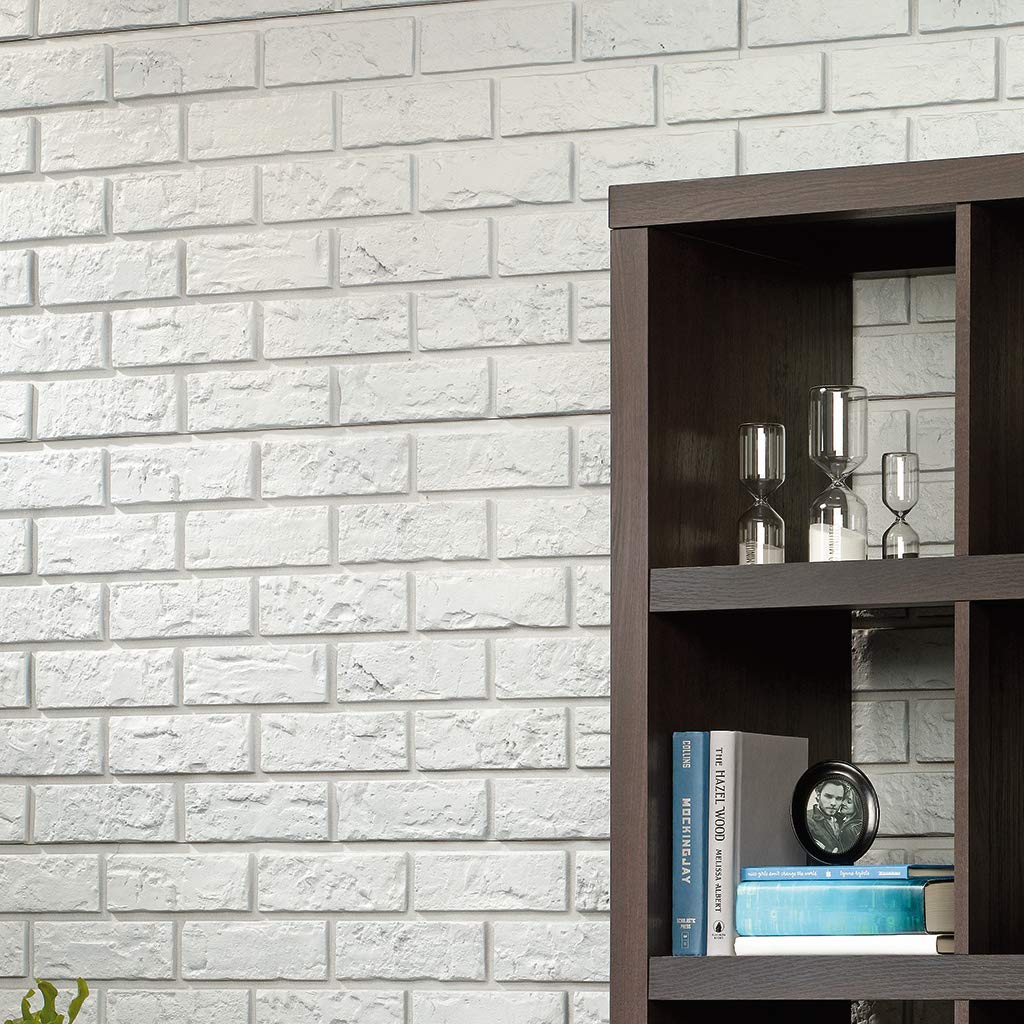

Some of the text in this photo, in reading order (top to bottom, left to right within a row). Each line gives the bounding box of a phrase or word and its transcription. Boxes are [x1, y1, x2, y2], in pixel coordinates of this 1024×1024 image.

[682, 740, 691, 769] COLLINS
[714, 747, 725, 842] THE HAZEL WOOD
[681, 797, 691, 884] MOCKINGJAY
[714, 848, 722, 913] MELISSA ALBERT
